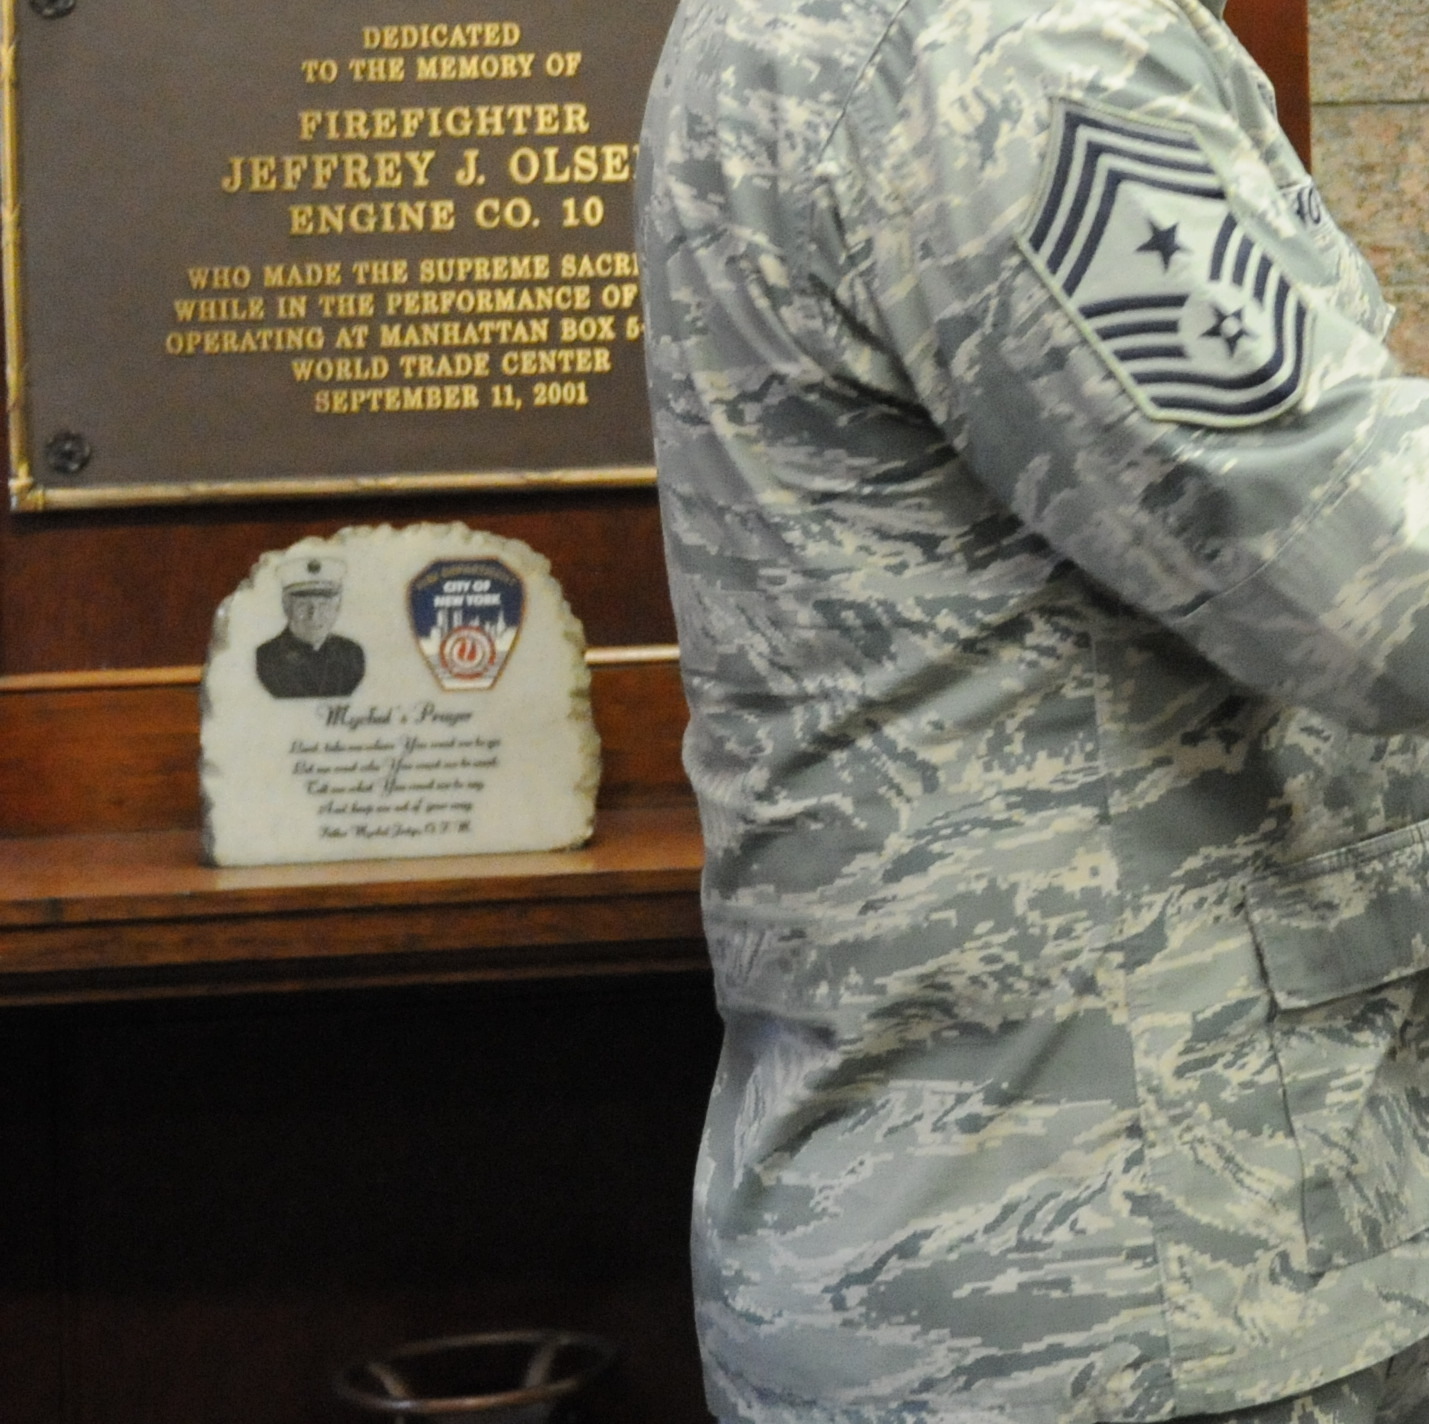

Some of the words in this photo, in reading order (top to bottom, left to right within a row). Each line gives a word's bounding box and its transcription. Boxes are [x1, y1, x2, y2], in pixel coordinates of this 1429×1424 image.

[363, 21, 521, 49] DEDICATED
[301, 59, 338, 82] TO
[348, 56, 404, 81] THE
[416, 52, 536, 79] MEMORY
[544, 51, 583, 77] OF
[299, 102, 590, 140] FIREFIGHTER
[222, 150, 435, 192] JEFFREY
[455, 148, 486, 187] J.
[508, 142, 640, 185] OLSE
[290, 199, 456, 234] ENGINE
[474, 196, 540, 229] CO.
[562, 195, 604, 228] 10
[188, 266, 251, 288] WHO
[264, 262, 342, 287] MADE
[352, 260, 408, 285] THE
[419, 255, 550, 283] SUPREME
[174, 298, 264, 321] WHILE
[278, 295, 307, 318] IN
[319, 293, 374, 316] THE
[388, 286, 590, 314] PERFORMANCE
[601, 284, 638, 308] OF
[165, 327, 324, 353] OPERATING
[336, 326, 368, 348] AT
[381, 319, 548, 346] MANHATTAN
[562, 316, 616, 341] BOX
[292, 357, 389, 381] WORLD
[400, 353, 489, 377] TRADE
[502, 347, 612, 375] CENTER
[315, 384, 480, 413] SEPTEMBER
[491, 384, 523, 411] 11,
[532, 380, 589, 407] 2001
[443, 580, 471, 594] CITY
[472, 580, 491, 592] OF
